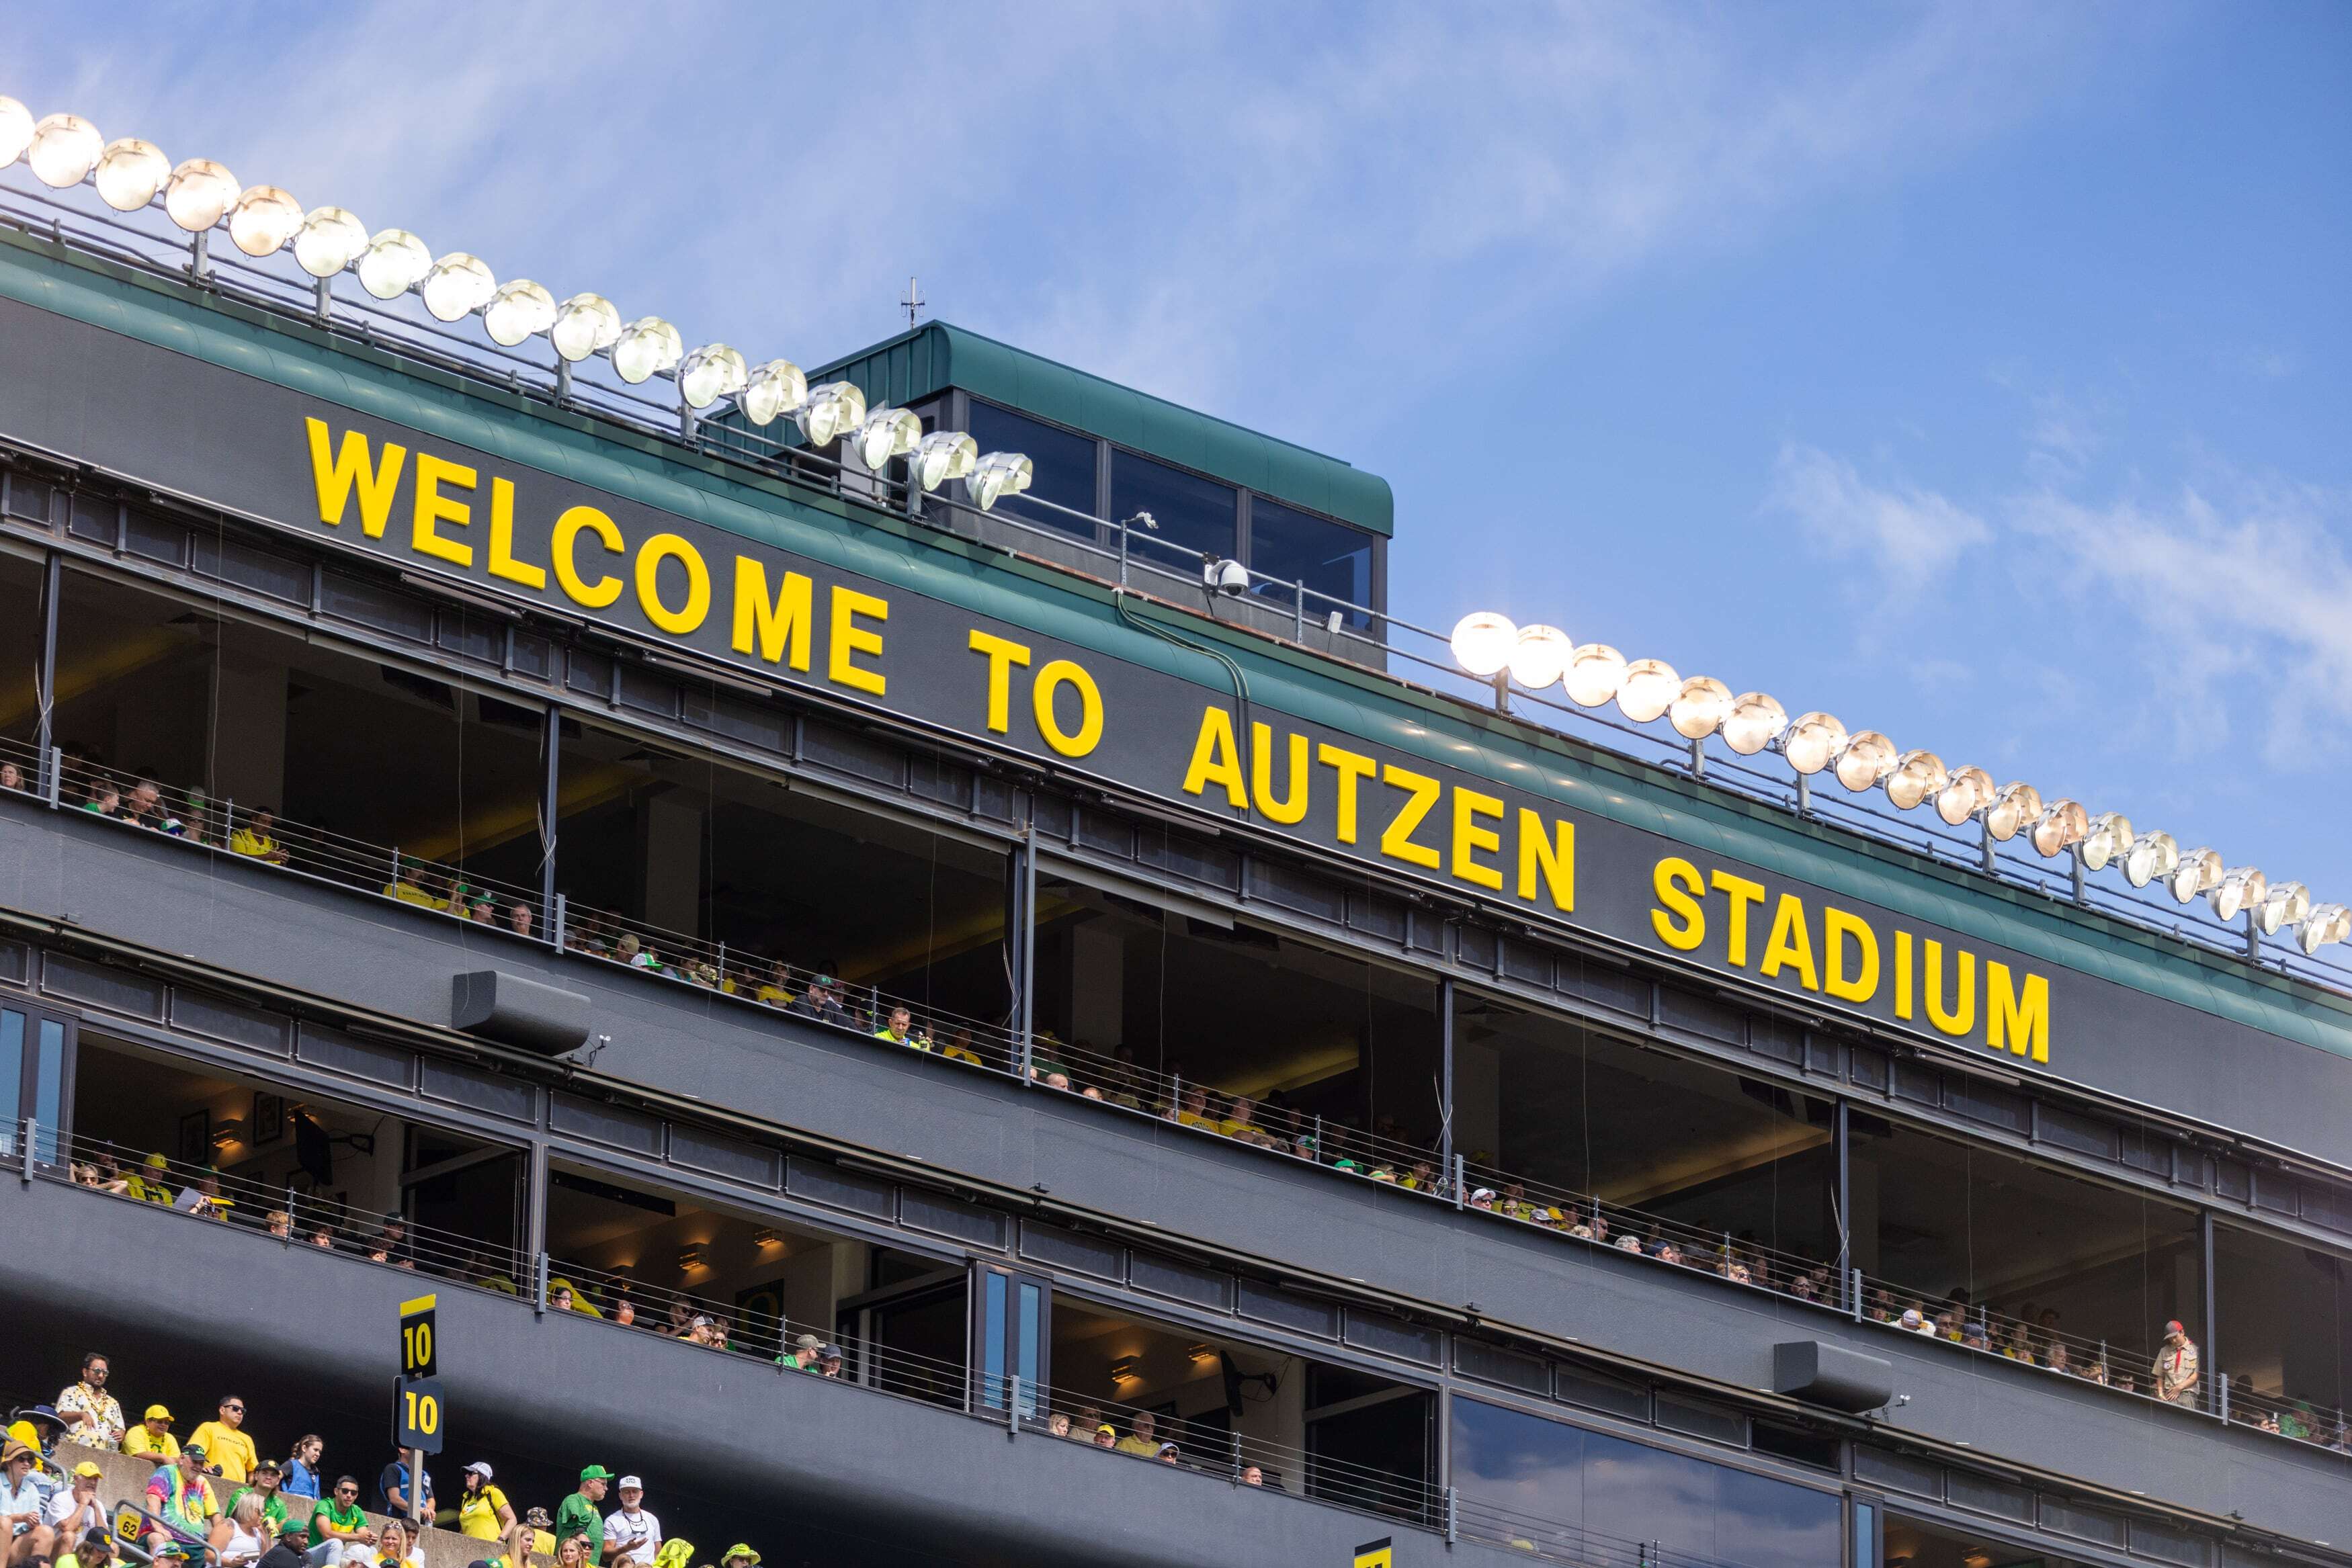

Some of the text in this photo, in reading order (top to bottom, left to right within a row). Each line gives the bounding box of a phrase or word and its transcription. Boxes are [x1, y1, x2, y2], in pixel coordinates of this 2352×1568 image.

[304, 416, 2050, 1065] WELCOME TO AUTZEN STADIUM
[405, 1323, 431, 1369] 10
[406, 1391, 437, 1434] 10
[122, 1521, 136, 1536] 62
